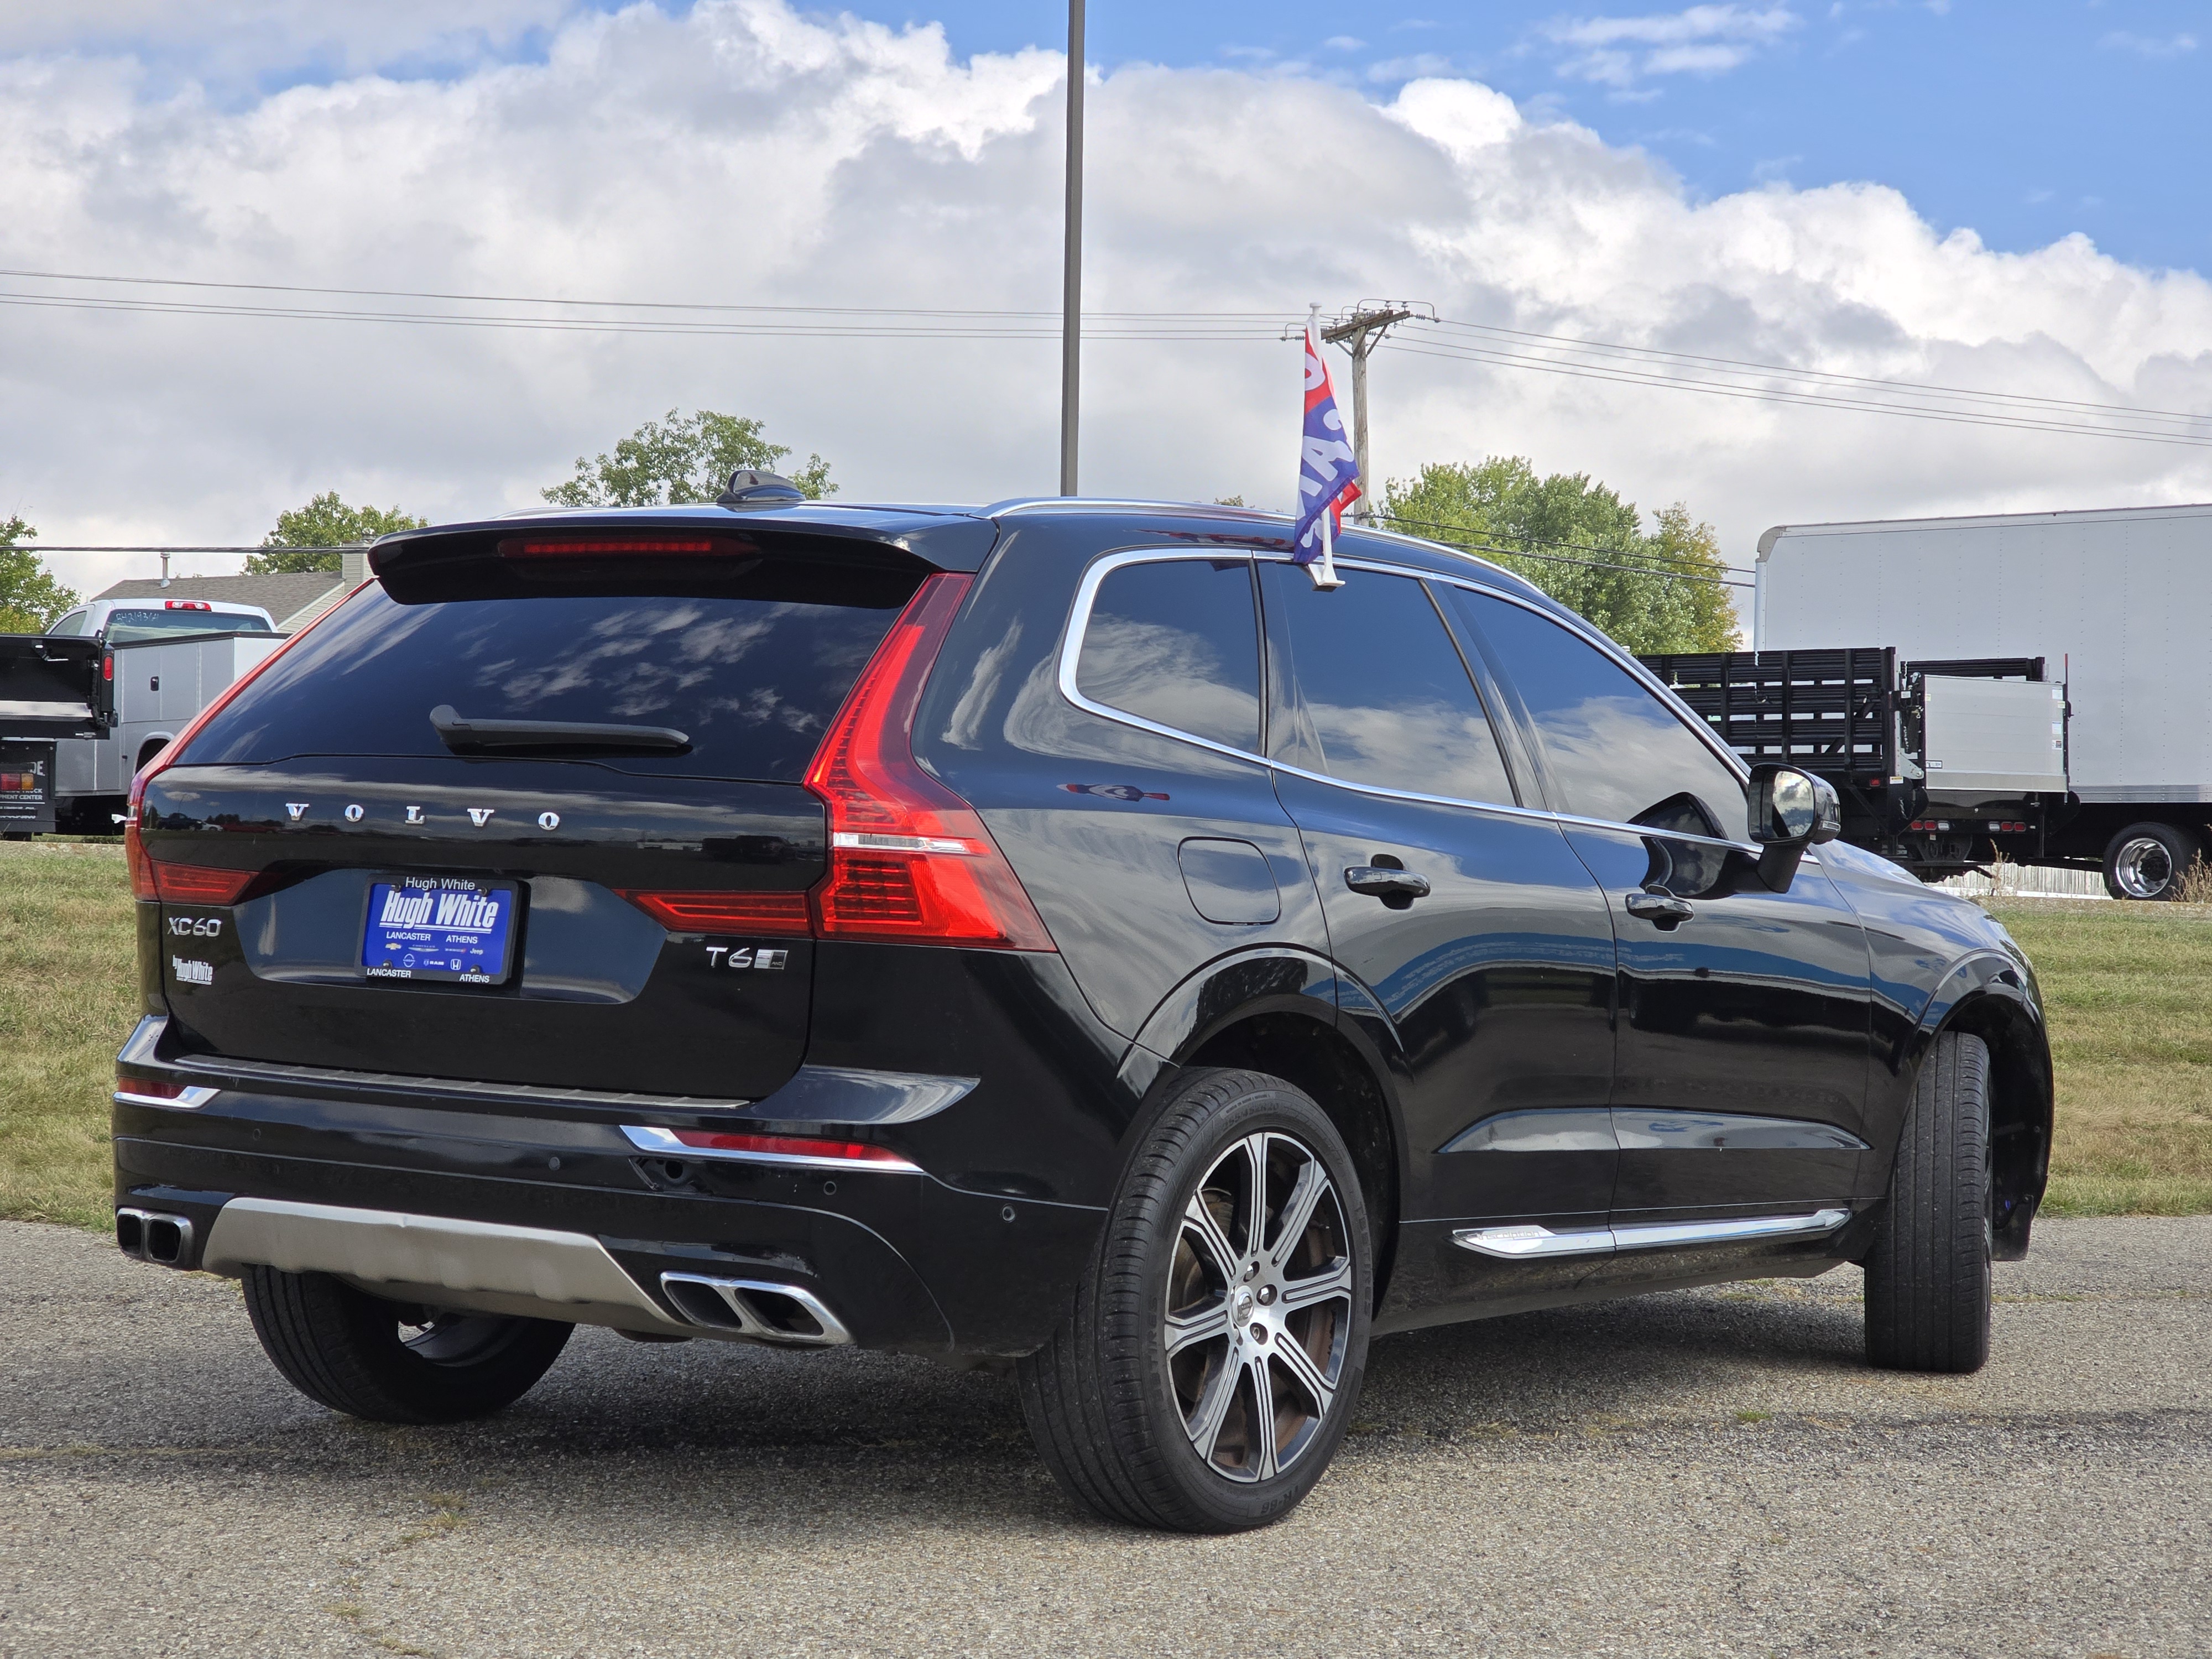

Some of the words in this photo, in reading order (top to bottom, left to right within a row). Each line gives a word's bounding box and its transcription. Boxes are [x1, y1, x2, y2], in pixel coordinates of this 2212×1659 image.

[285, 803, 560, 830] VOLVO
[405, 877, 437, 891] Hugh
[441, 878, 476, 890] White
[380, 890, 433, 929] Hugh
[435, 893, 499, 928] White
[167, 917, 222, 937] XC60
[386, 931, 431, 941] LANCASTER
[446, 935, 478, 944] ATHENS
[706, 947, 753, 968] T6
[192, 961, 213, 982] White
[367, 968, 411, 978] LANCASTER
[459, 974, 490, 983] ATHENS
